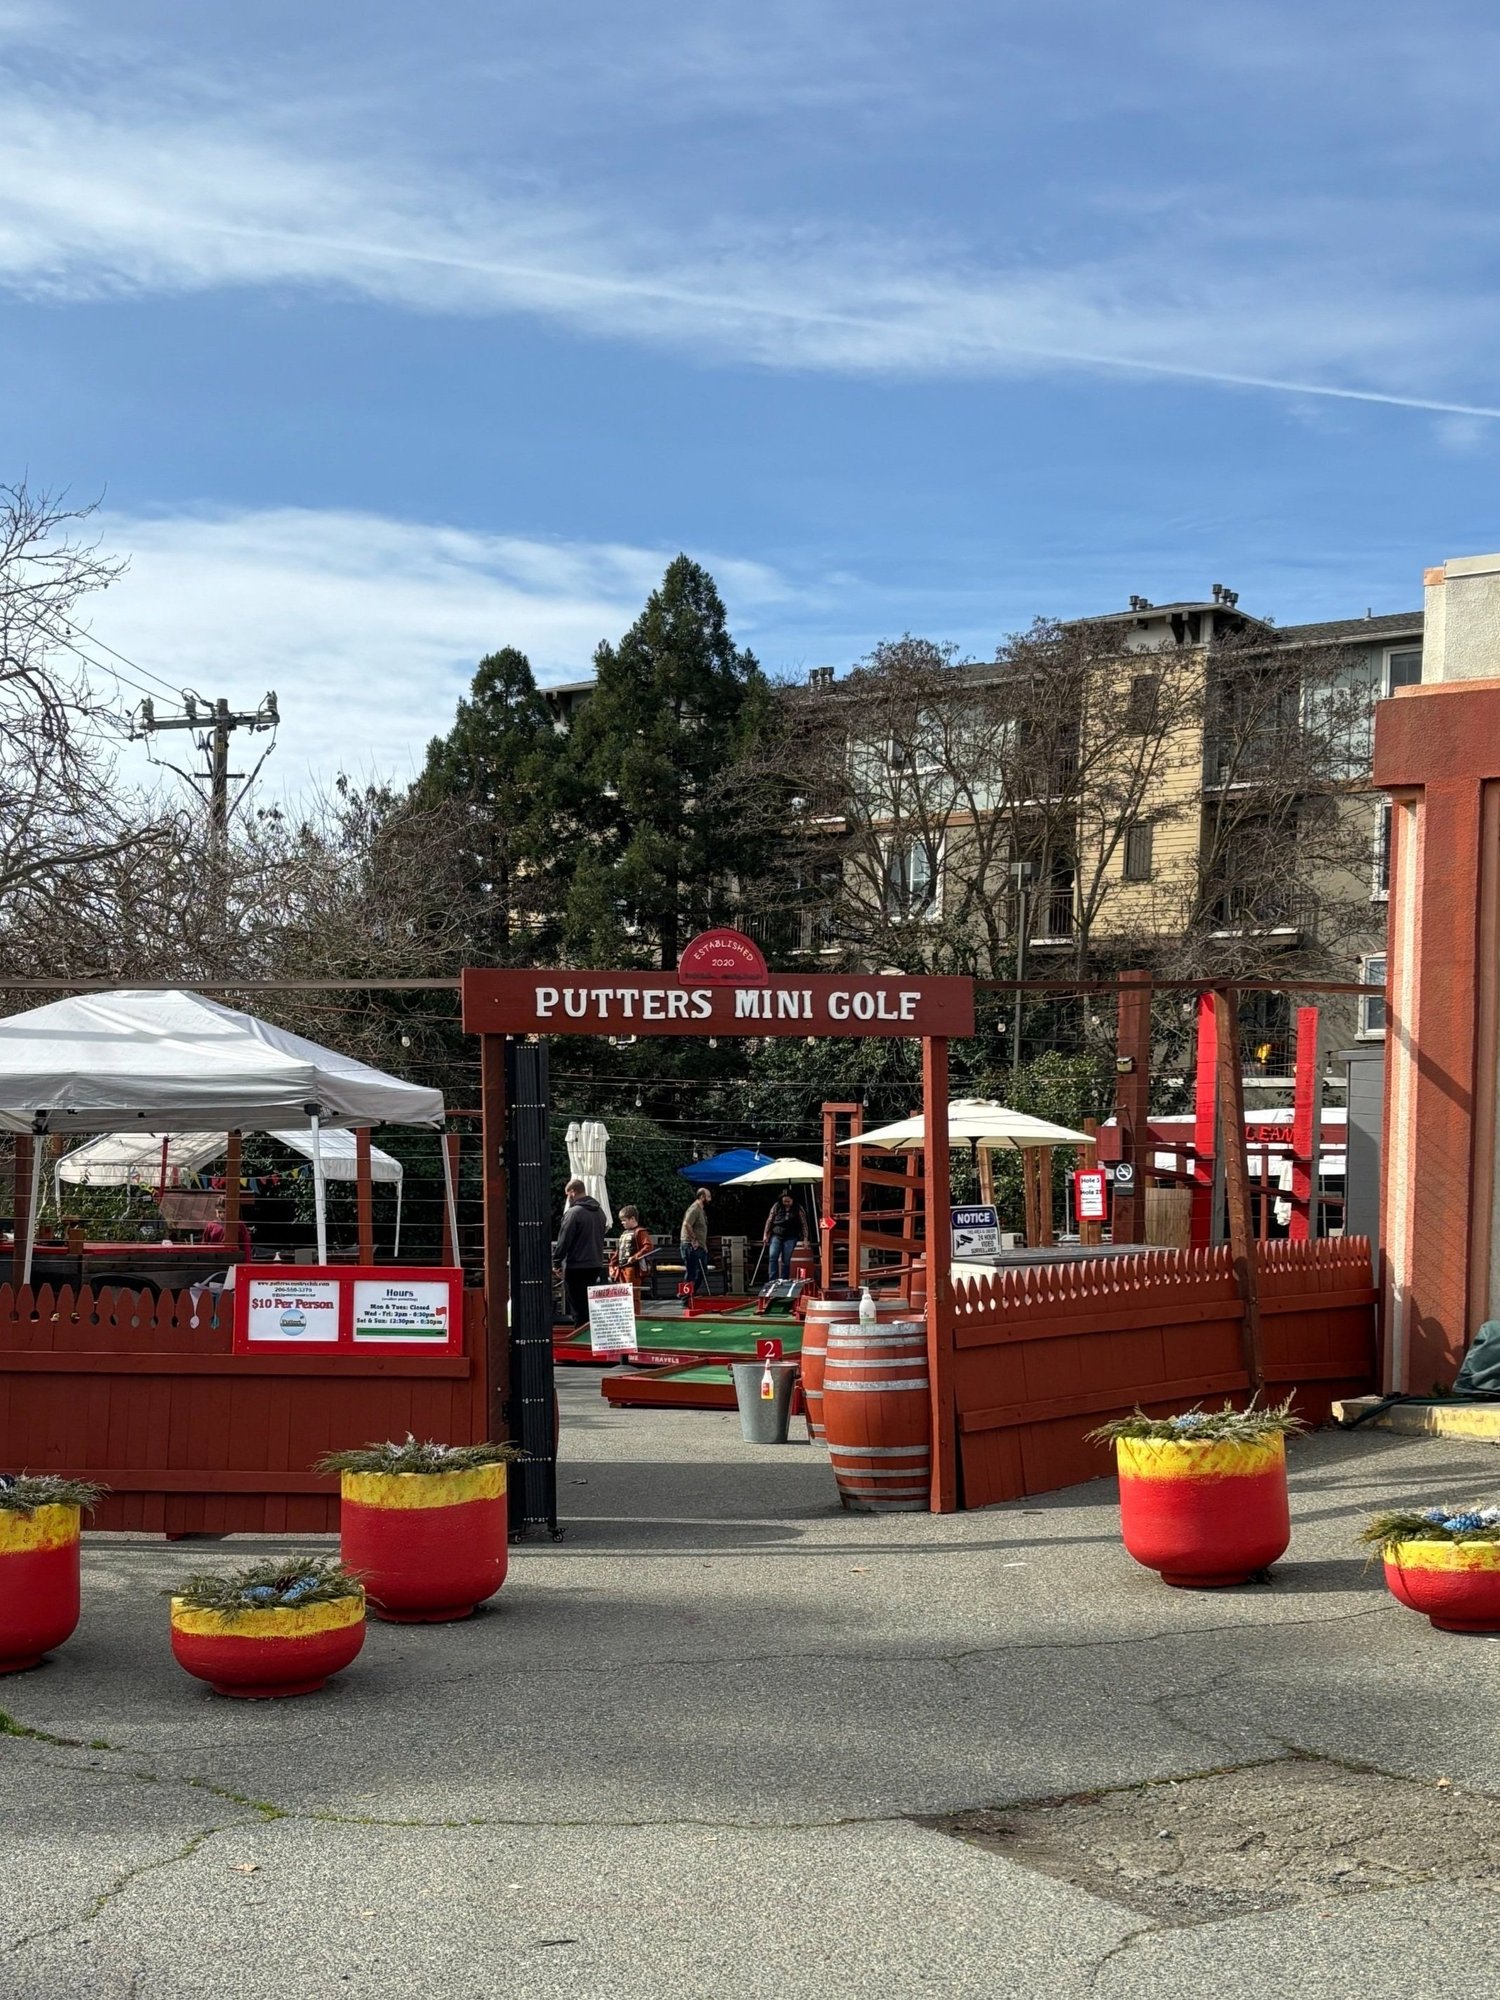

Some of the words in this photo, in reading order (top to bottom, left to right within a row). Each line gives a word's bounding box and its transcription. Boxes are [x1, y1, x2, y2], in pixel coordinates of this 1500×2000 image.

[693, 940, 754, 961] ESTABLISHED
[712, 959, 735, 967] 2020
[535, 987, 713, 1020] PUTTERS
[734, 989, 813, 1019] MINI
[827, 991, 921, 1020] GOLF
[957, 1212, 991, 1224] NOTICE
[386, 1289, 414, 1297] Hours
[683, 1284, 690, 1294] 6
[252, 1298, 272, 1309] $10
[274, 1299, 293, 1309] Per
[295, 1299, 334, 1309] Person
[764, 1341, 776, 1357] 2
[651, 1356, 680, 1364] TRAVELS
